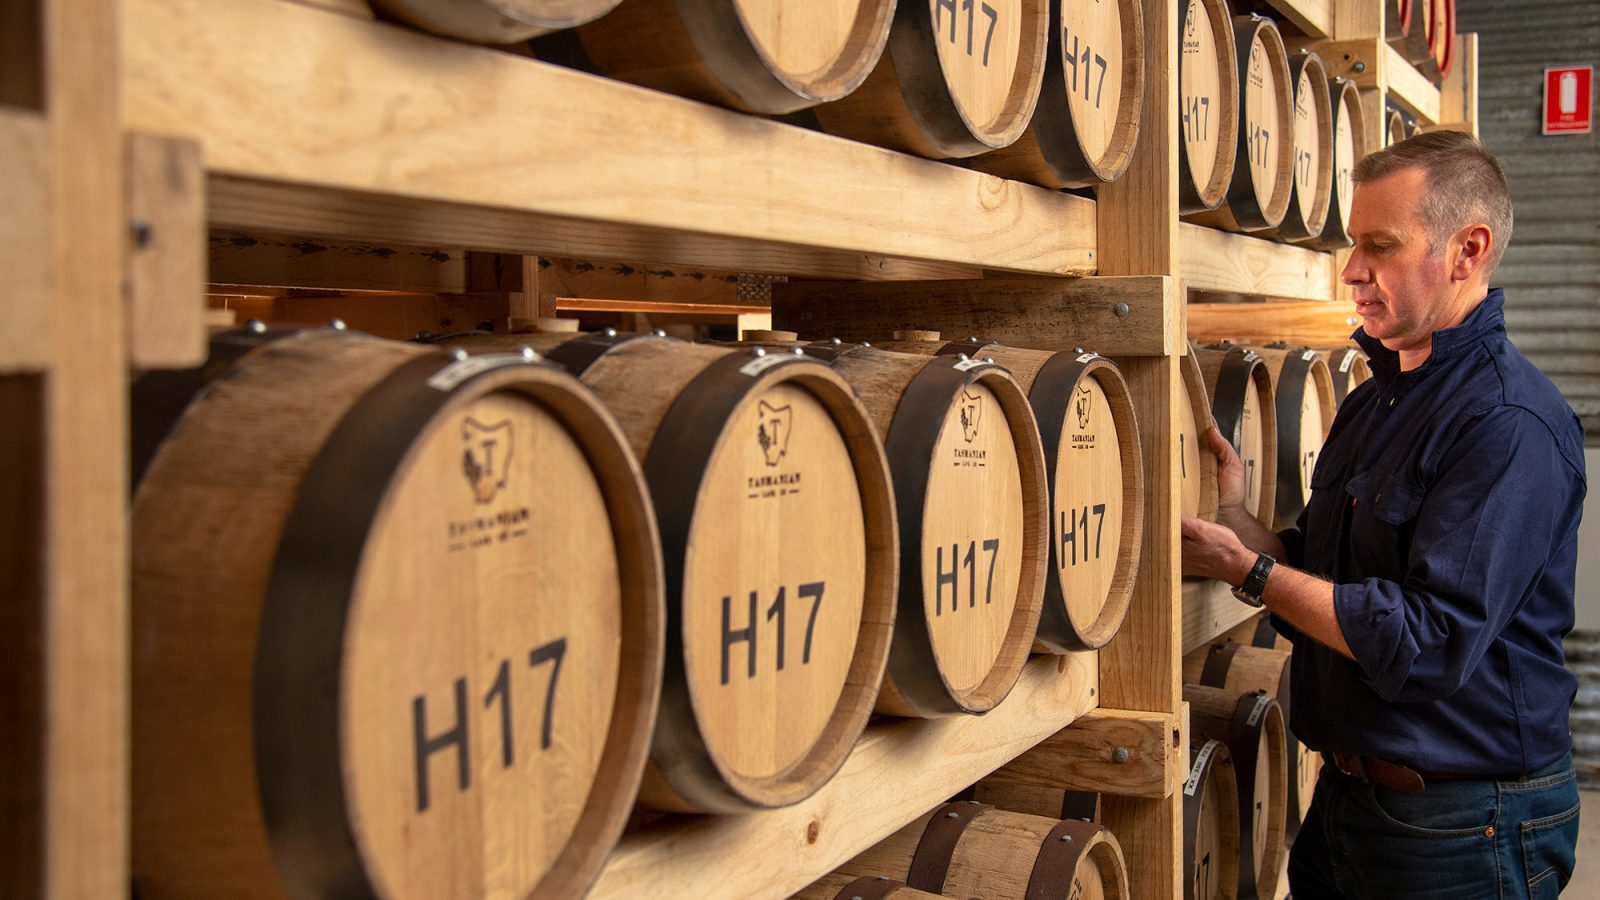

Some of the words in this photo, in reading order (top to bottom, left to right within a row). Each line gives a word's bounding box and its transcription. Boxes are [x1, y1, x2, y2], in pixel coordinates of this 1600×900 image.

[936, 0, 998, 67] H17
[1064, 26, 1107, 109] H17
[1295, 147, 1311, 188] 17
[953, 448, 986, 459] TASMANIAN
[1060, 503, 1106, 570] H17
[936, 538, 1000, 617] H17
[720, 581, 826, 687] H17
[413, 637, 568, 814] H17
